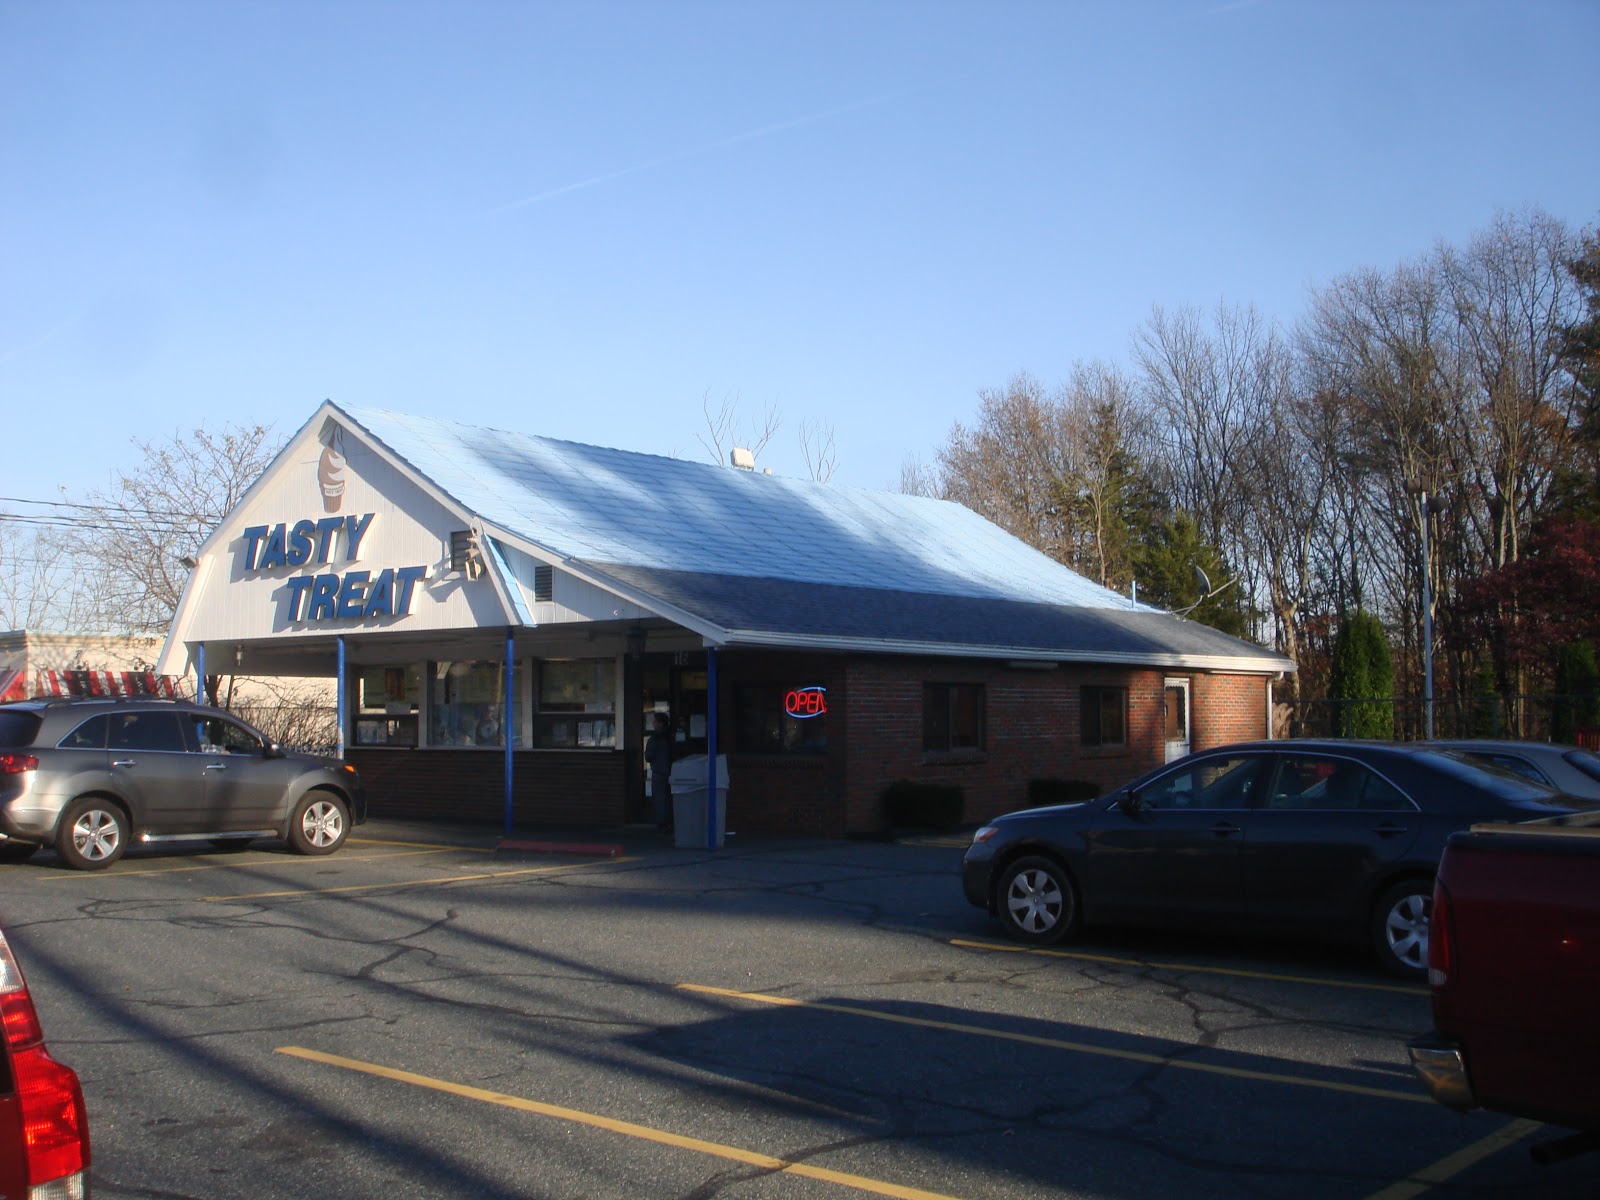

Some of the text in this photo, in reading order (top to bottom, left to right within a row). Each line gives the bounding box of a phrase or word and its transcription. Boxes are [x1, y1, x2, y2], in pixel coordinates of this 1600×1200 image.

[244, 513, 376, 570] TASTY
[286, 565, 428, 622] TREAT
[785, 691, 827, 714] OPEN
